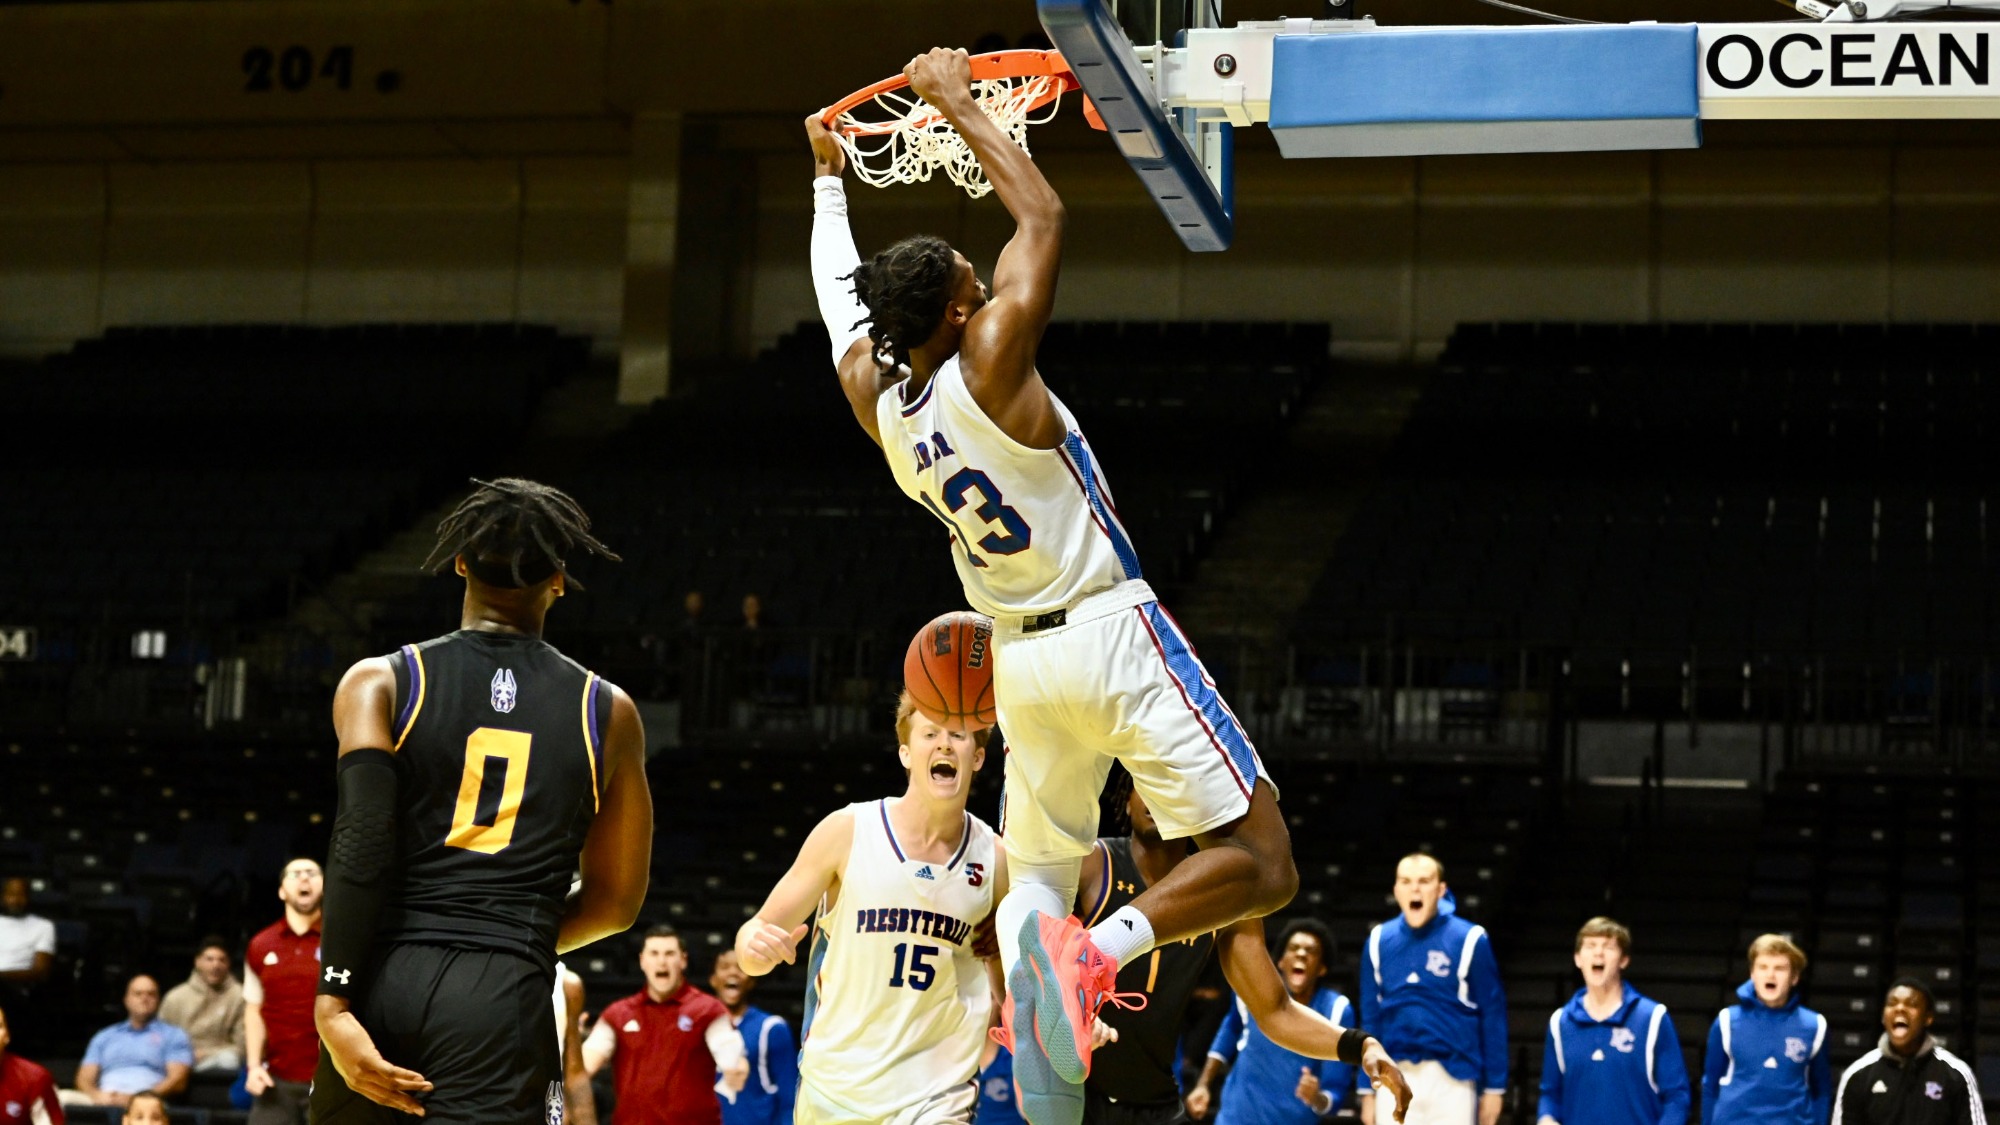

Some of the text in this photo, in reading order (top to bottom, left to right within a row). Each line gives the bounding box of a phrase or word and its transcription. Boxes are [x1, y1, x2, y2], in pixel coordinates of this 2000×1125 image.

[243, 46, 353, 89] 204
[1706, 33, 1989, 89] OCEAN
[967, 615, 993, 669] ilson
[444, 727, 532, 855] 0
[889, 943, 939, 991] 15
